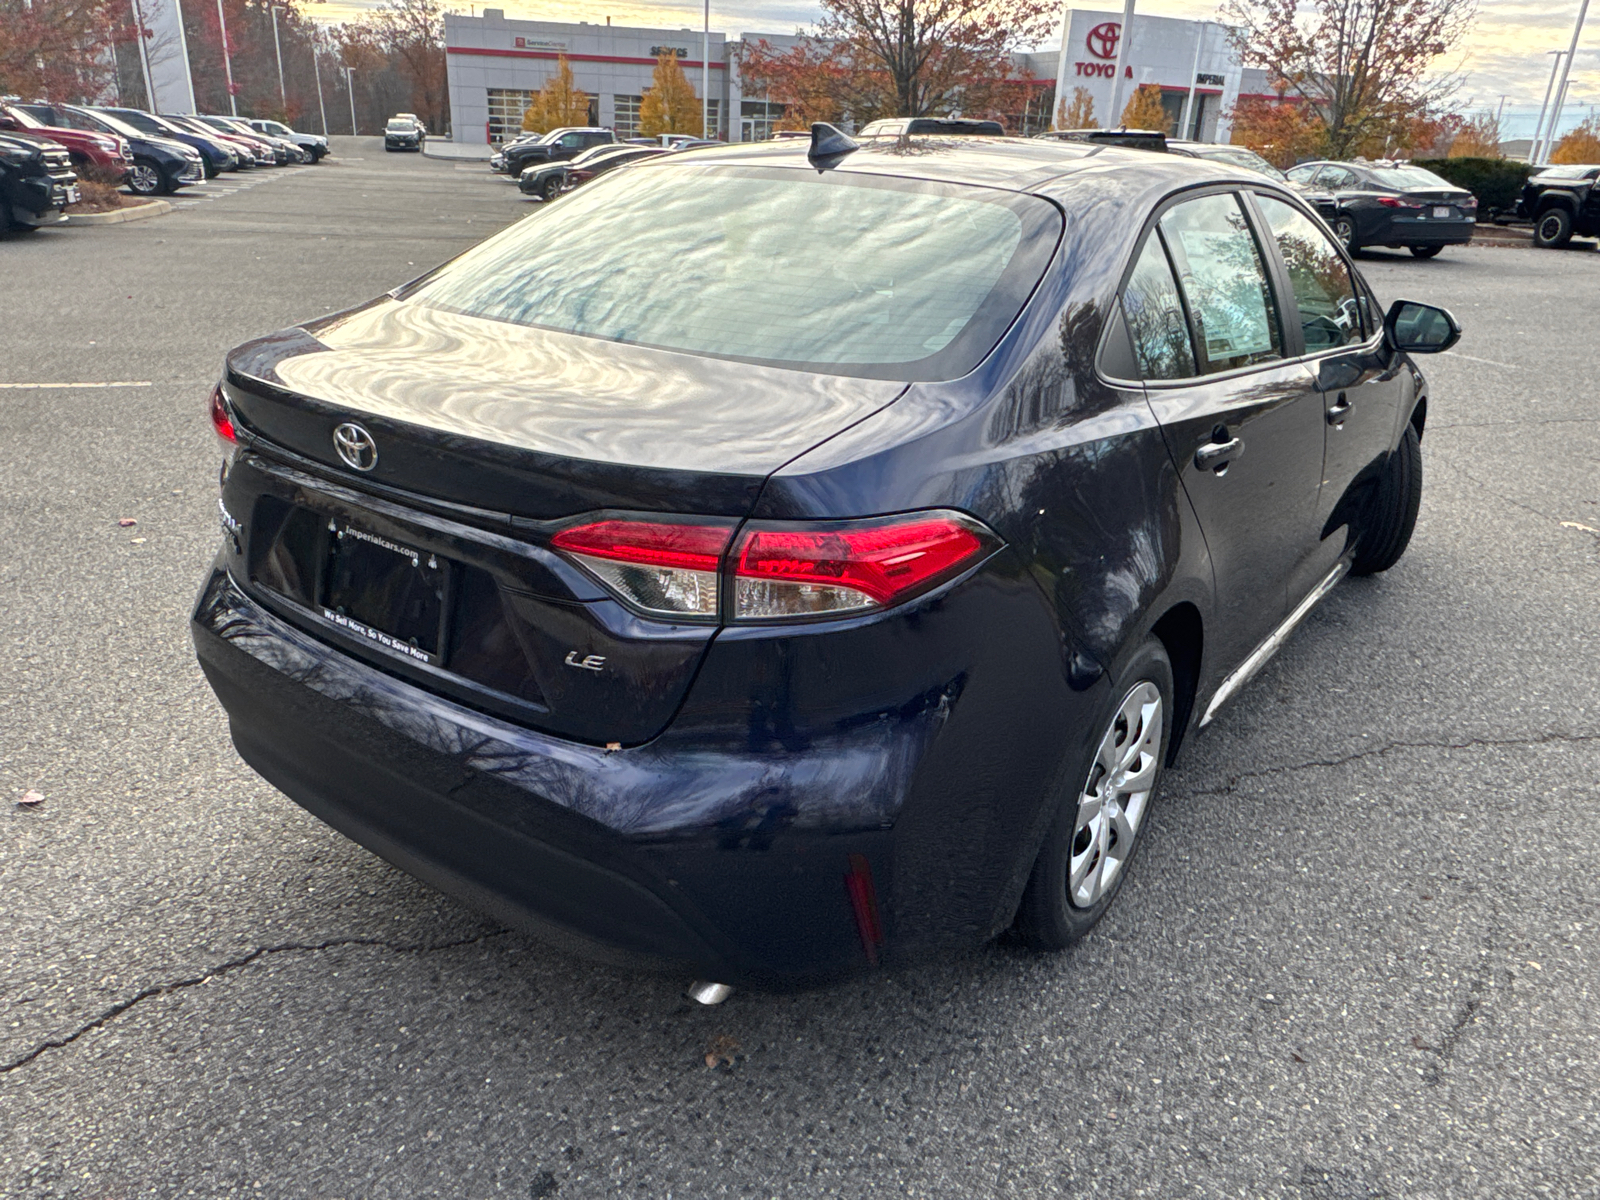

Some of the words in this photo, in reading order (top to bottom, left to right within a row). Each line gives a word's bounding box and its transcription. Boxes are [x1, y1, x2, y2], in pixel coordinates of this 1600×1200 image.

[1075, 62, 1133, 79] TOYOA
[345, 525, 419, 559] Imperialcars.com
[324, 609, 335, 621] We
[335, 614, 348, 627] Sell
[348, 620, 367, 636] More,
[367, 628, 377, 639] So
[377, 633, 391, 646] You
[391, 639, 410, 654] Save
[410, 646, 429, 662] More
[565, 650, 607, 671] LE
